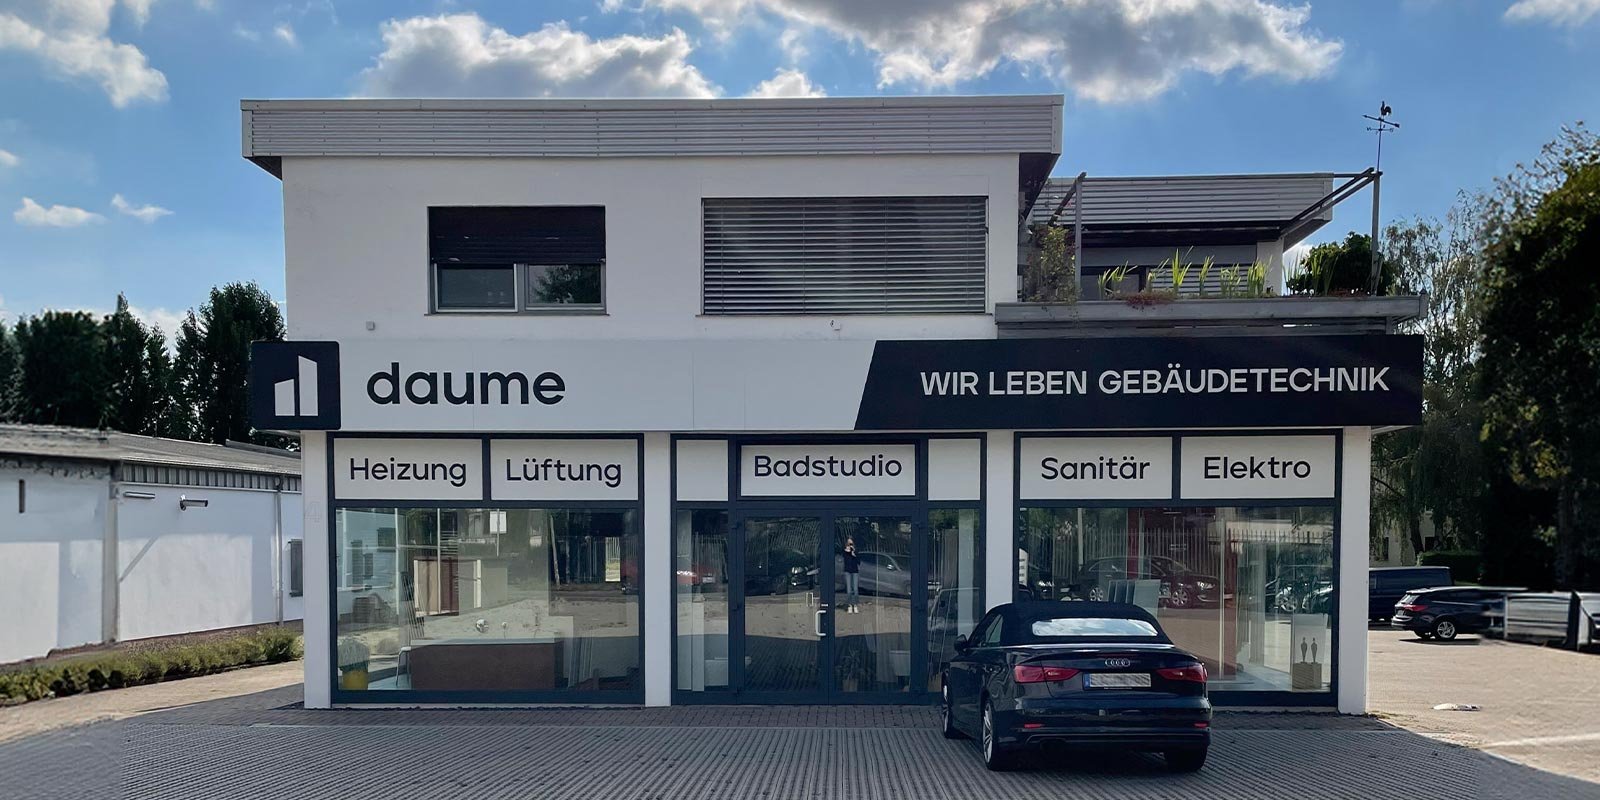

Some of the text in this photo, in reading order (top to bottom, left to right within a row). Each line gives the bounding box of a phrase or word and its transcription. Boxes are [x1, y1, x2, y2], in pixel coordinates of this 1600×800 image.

[366, 361, 566, 406] daume
[920, 363, 1390, 396] WIR LEBEN GEBÄUDETECHNIK
[349, 456, 467, 488] Heizung
[506, 457, 622, 488] Lüftung
[753, 454, 903, 477] Badstudio
[1040, 455, 1151, 480] Sanitär
[1203, 455, 1311, 480] Elektro
